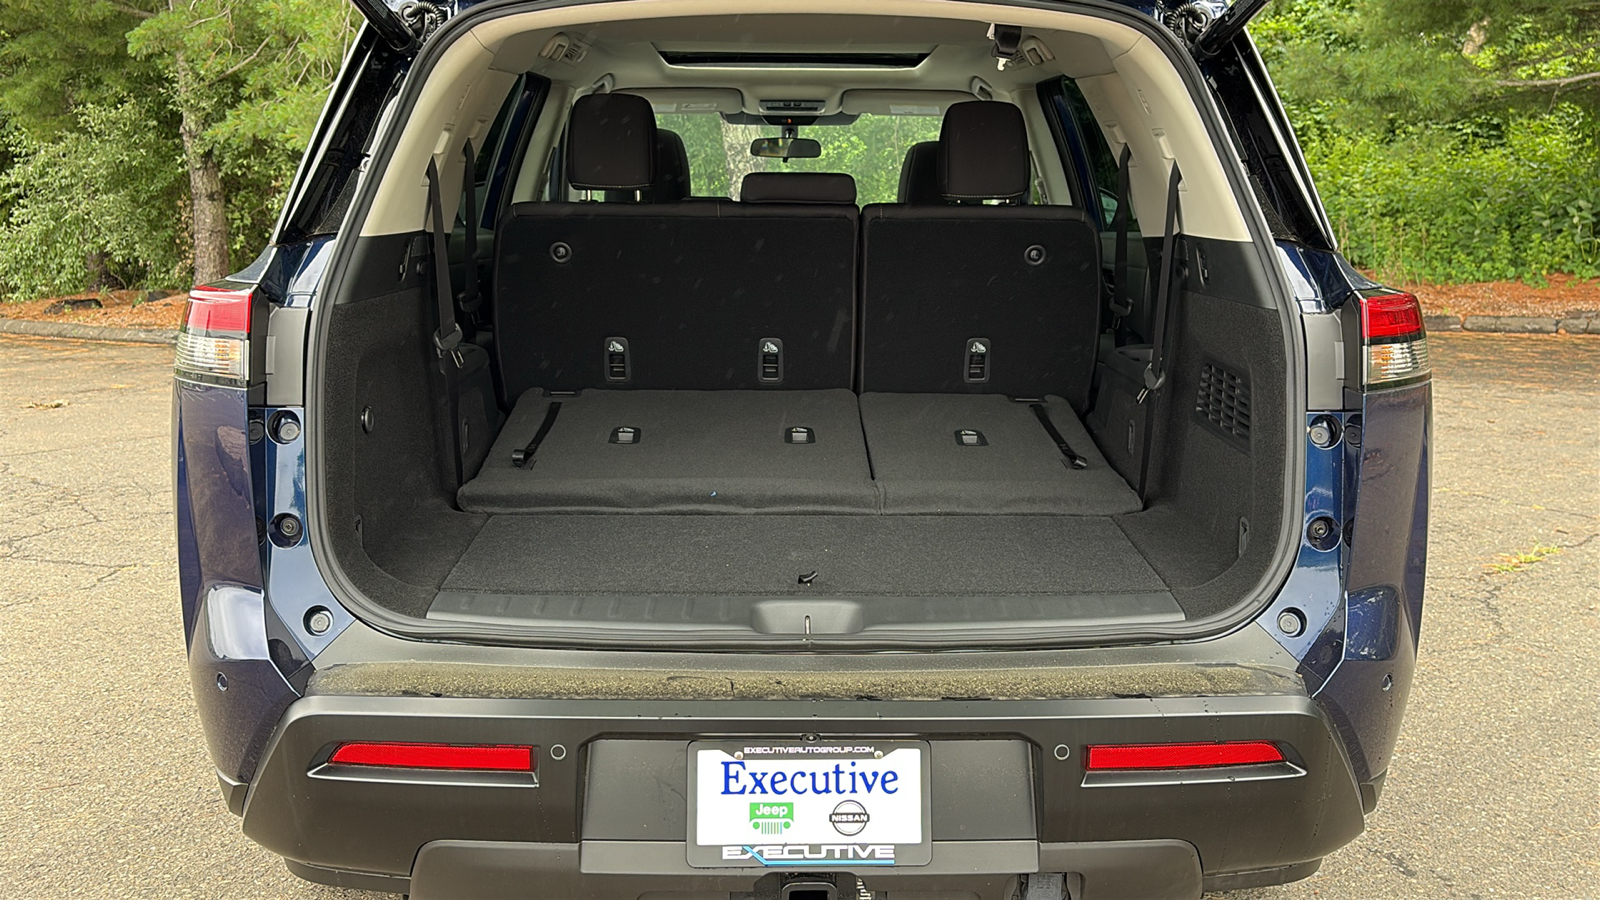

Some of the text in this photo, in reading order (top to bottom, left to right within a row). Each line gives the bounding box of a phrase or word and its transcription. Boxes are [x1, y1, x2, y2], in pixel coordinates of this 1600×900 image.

[743, 746, 875, 755] EXECUTIVEAUTOGROUP.COM
[720, 761, 899, 795] Executive
[755, 804, 788, 818] Jeep
[831, 814, 868, 822] NISSAN
[721, 845, 896, 860] EXECUTIVE
